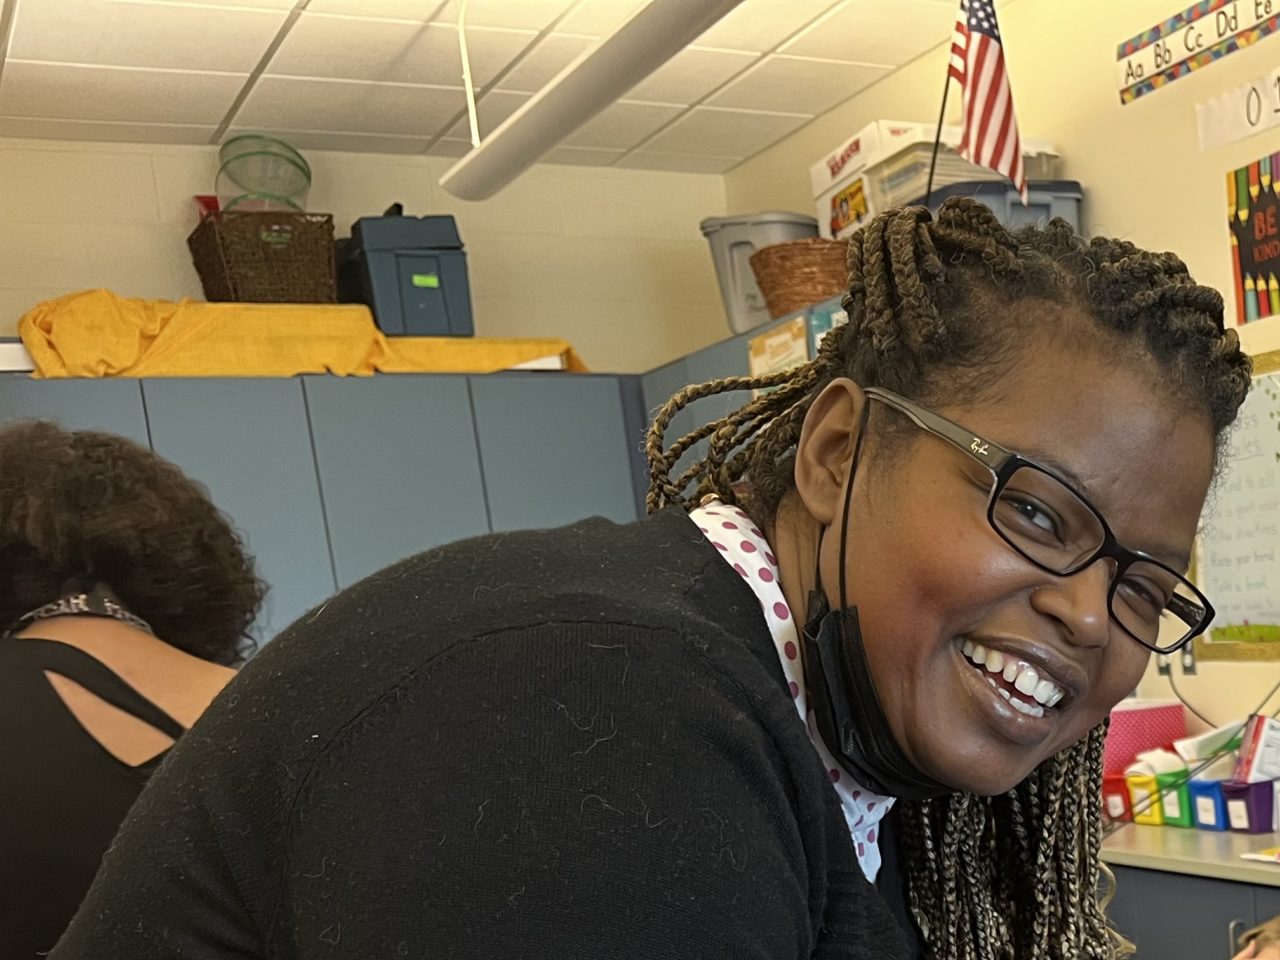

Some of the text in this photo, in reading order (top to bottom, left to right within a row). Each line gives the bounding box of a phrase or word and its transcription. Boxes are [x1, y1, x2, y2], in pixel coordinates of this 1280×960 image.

[1125, 60, 1144, 85] Aa
[1154, 42, 1172, 69] Bb
[1184, 26, 1203, 52] Cc
[1216, 2, 1238, 38] Dd
[1253, 206, 1278, 240] BE
[1253, 240, 1280, 262] KIND
